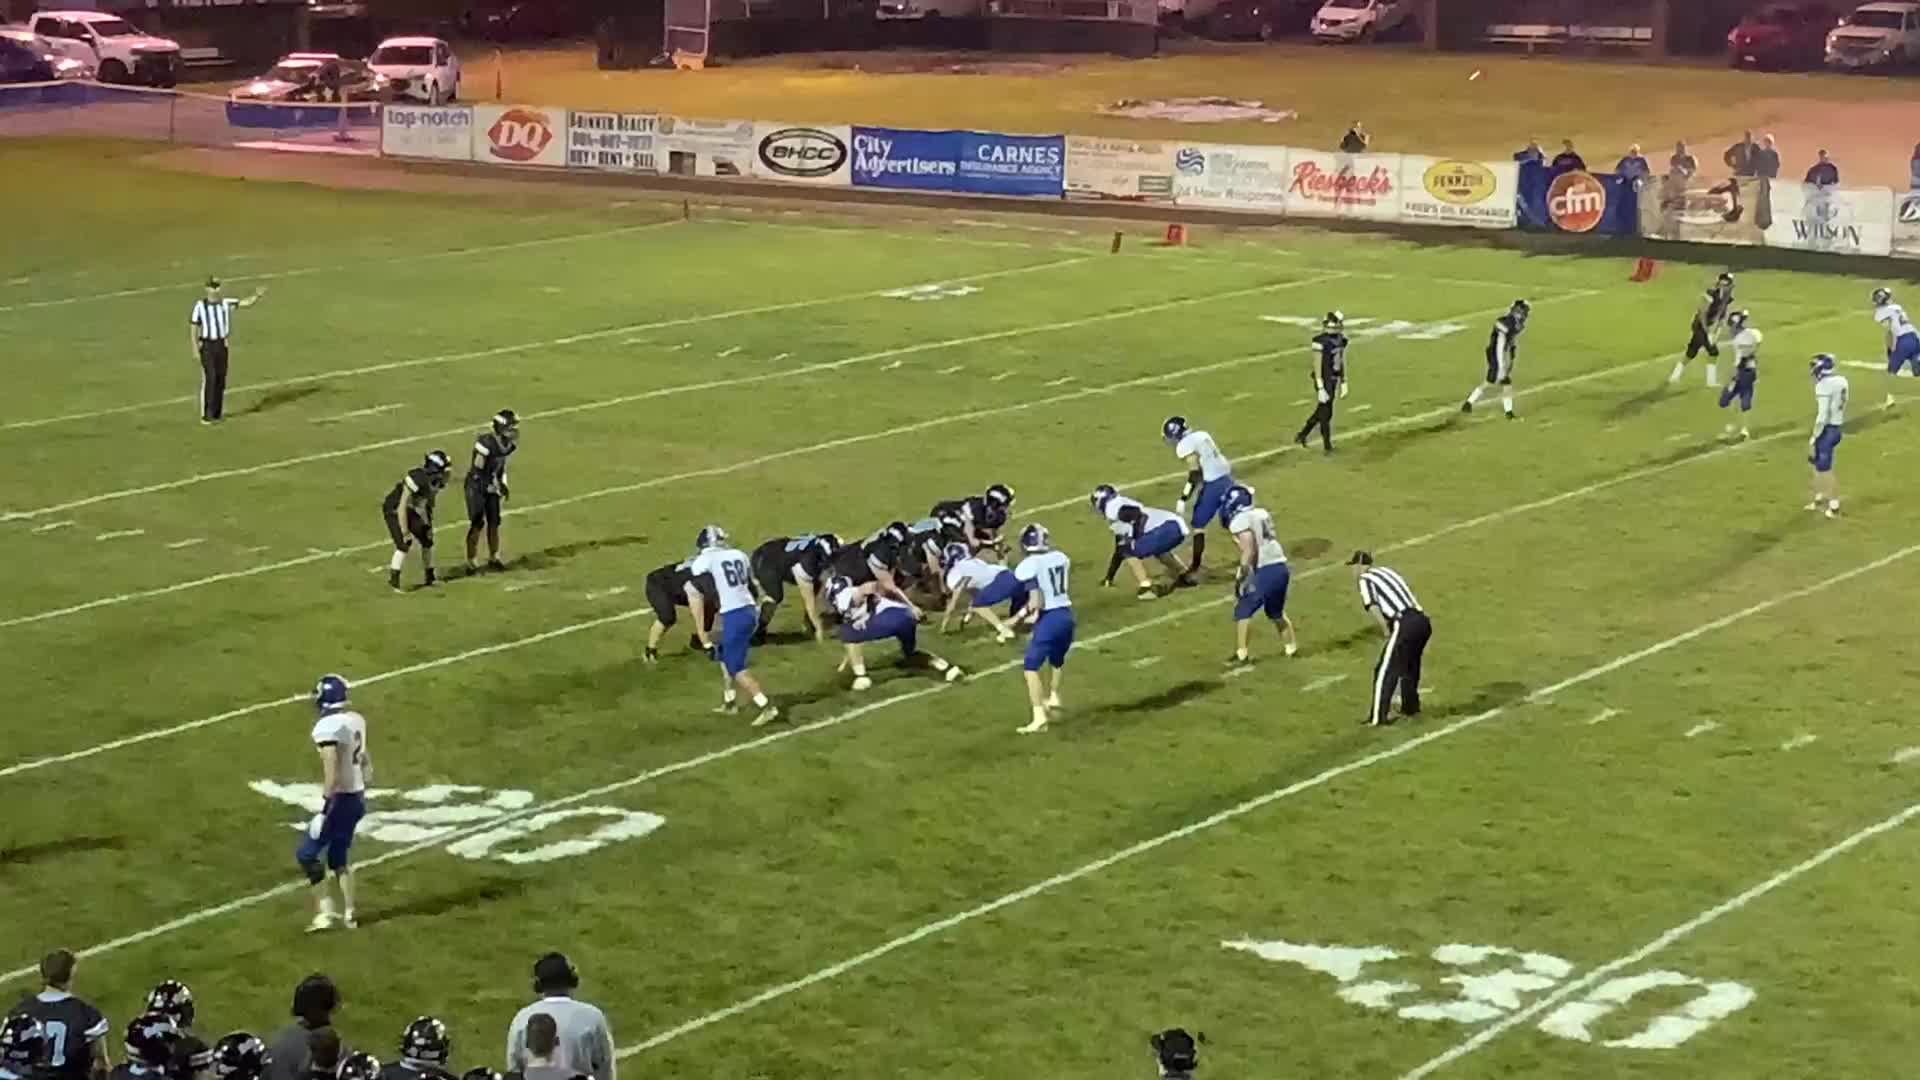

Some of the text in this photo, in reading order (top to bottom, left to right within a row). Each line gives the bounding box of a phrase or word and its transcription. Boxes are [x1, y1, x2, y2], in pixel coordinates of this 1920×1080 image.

[497, 121, 543, 153] DQ
[772, 144, 836, 161] BHCC
[853, 134, 892, 157] City
[853, 154, 956, 178] Advertisers
[978, 144, 1060, 164] CARNES
[1550, 184, 1601, 216] cfm
[1048, 565, 1066, 597] 17
[1335, 943, 1758, 1049] 30
[45, 1020, 67, 1067] 7
